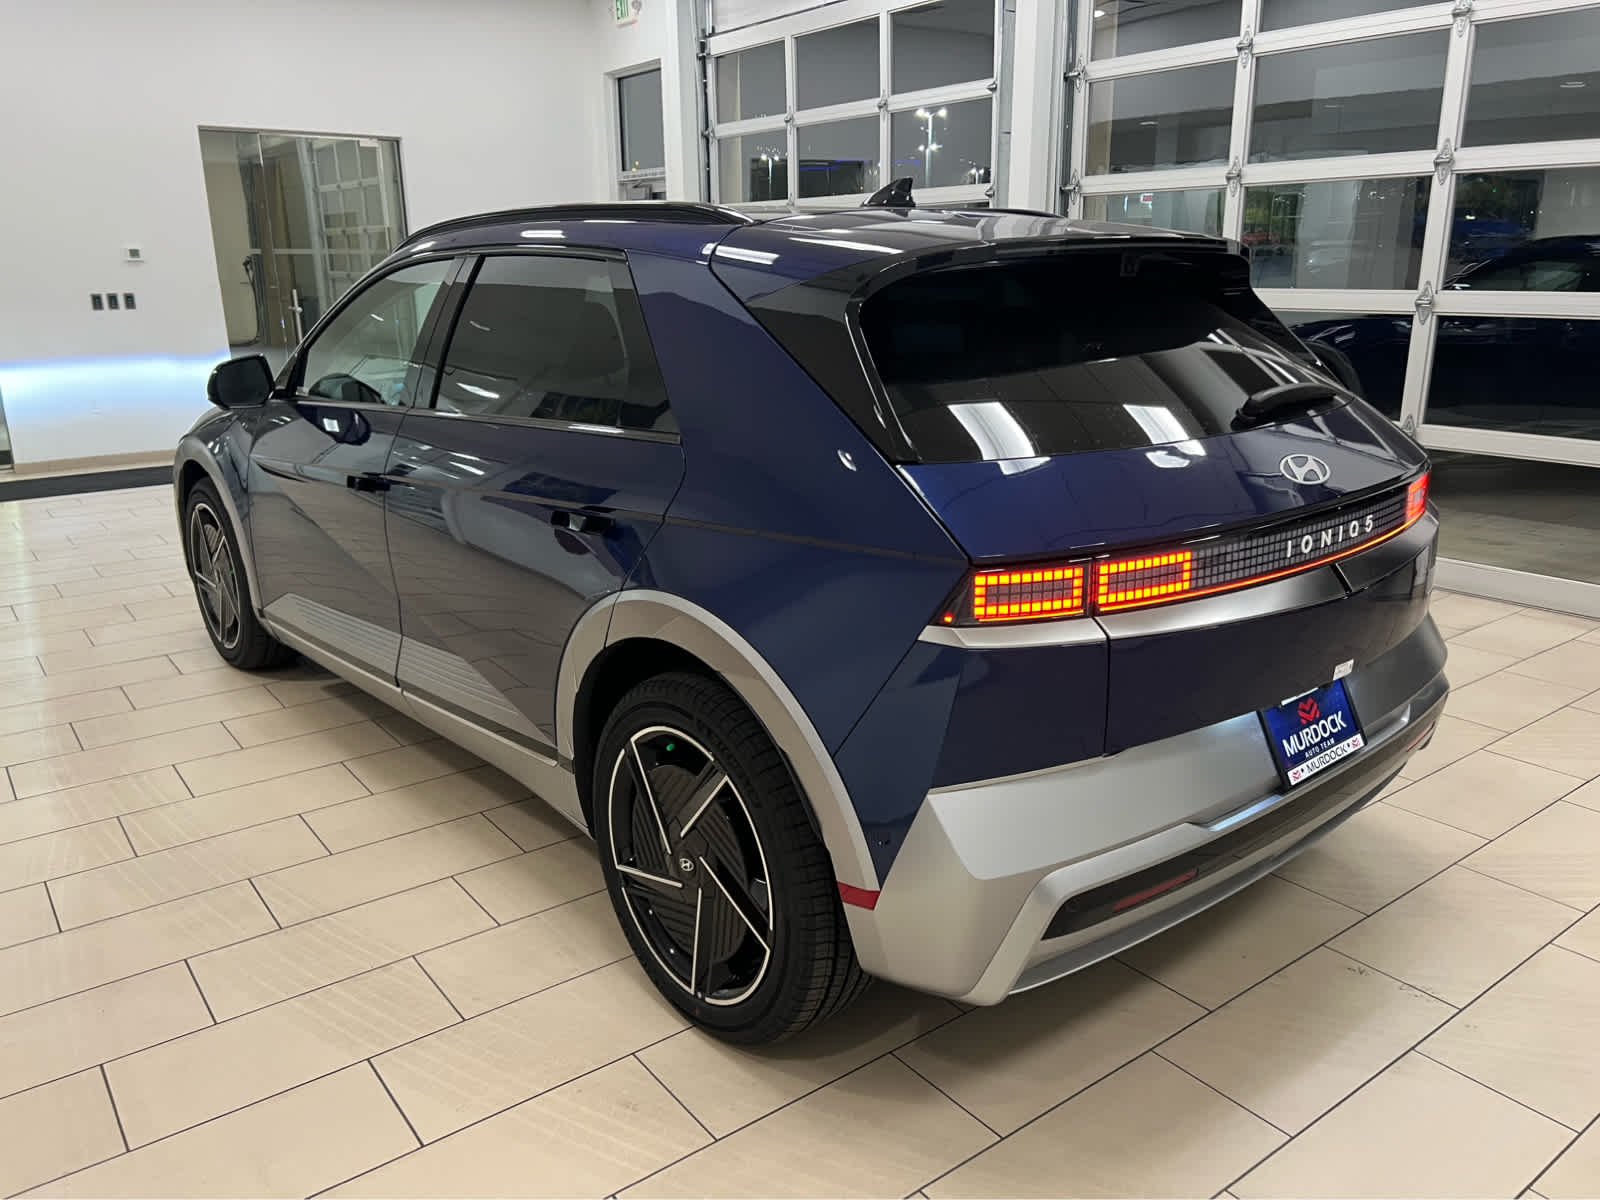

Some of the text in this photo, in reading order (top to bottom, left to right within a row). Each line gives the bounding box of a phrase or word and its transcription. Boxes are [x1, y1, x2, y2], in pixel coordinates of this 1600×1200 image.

[1282, 711, 1347, 758] MURDOCK
[1305, 738, 1335, 758] AUTO TEAM
[1306, 744, 1347, 773] MURDOCK
